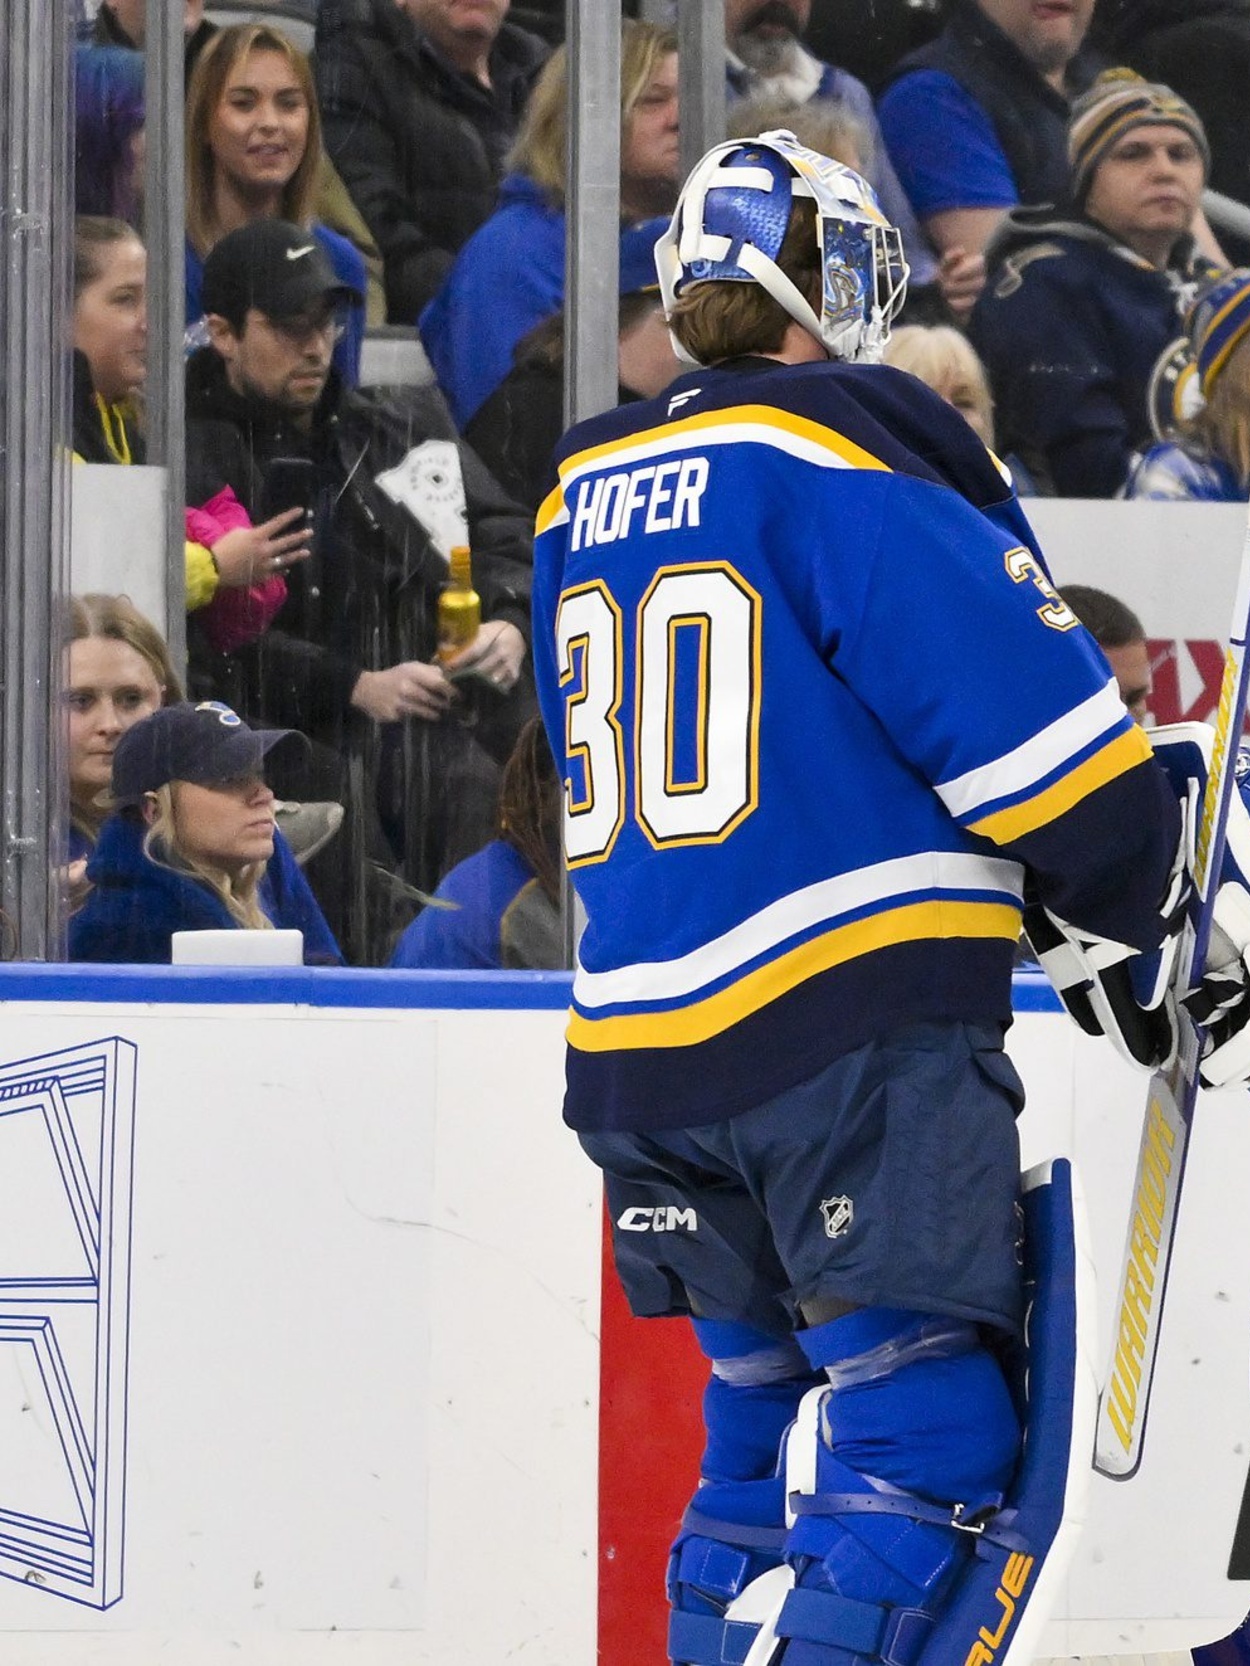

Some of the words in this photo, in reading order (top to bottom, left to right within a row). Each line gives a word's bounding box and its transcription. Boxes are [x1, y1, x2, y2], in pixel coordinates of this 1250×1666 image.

[571, 456, 710, 552] HOFER
[555, 559, 763, 872] 30
[616, 1206, 698, 1232] CCM
[1106, 1099, 1176, 1456] WARRIOR
